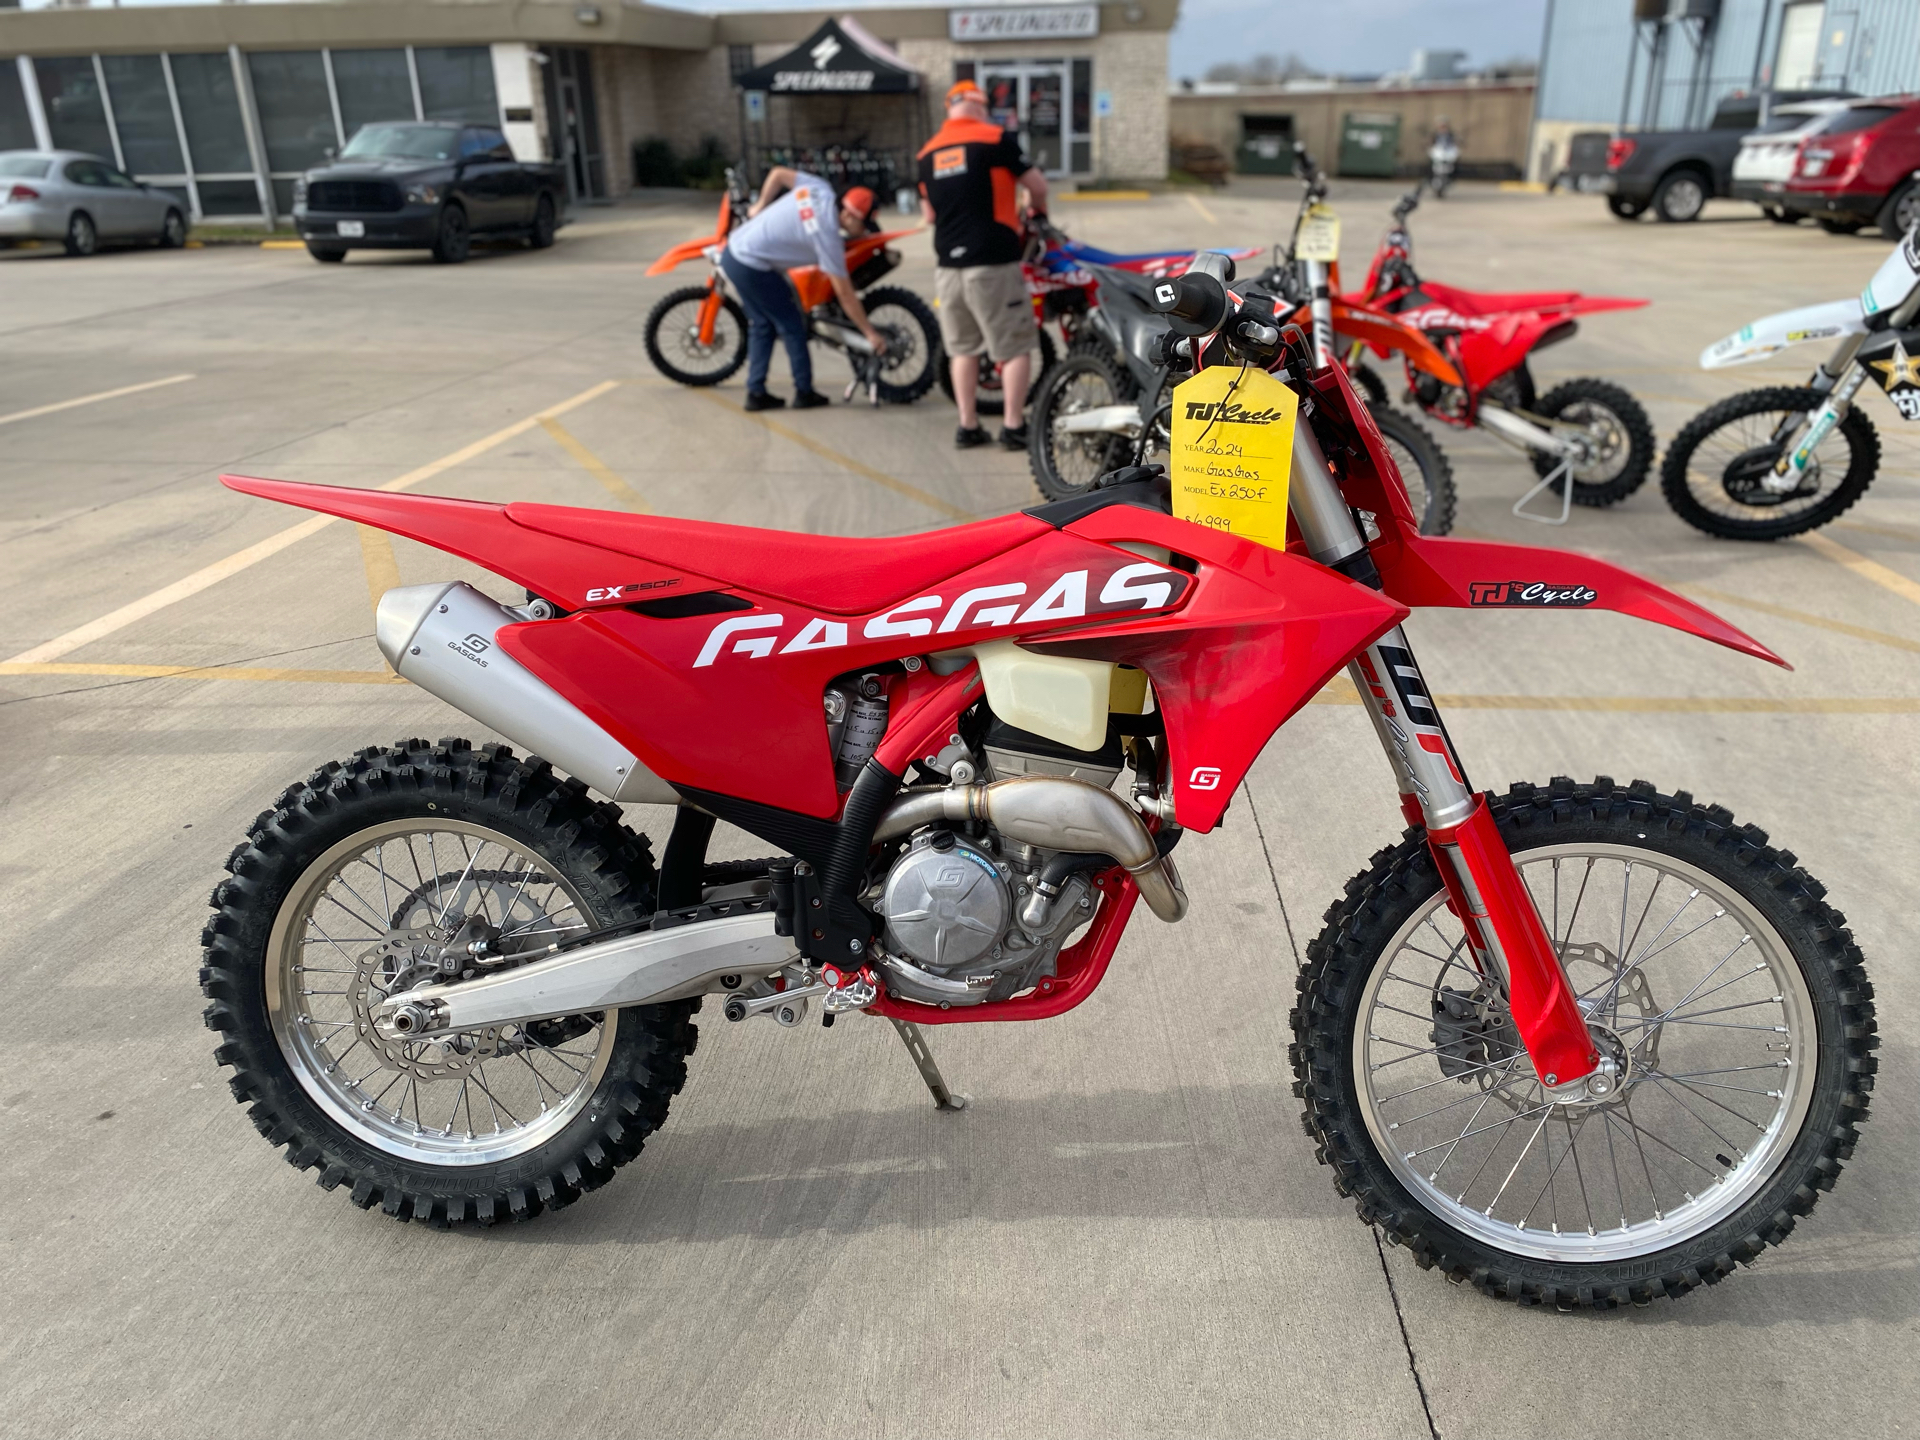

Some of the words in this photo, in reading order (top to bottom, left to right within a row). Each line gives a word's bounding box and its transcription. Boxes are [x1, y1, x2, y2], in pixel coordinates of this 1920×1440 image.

[1222, 403, 1282, 421] Cycle
[1184, 444, 1205, 453] YEAR
[1206, 439, 1243, 457] 2024
[1184, 465, 1206, 474] MAKE
[1184, 486, 1209, 495] MODEL
[585, 585, 624, 601] EX
[624, 578, 682, 593] 250F
[1521, 583, 1596, 604] Cycle
[692, 562, 1173, 669] GASGAS
[447, 641, 489, 668] GASGAS
[969, 852, 997, 878] MOTOREX
